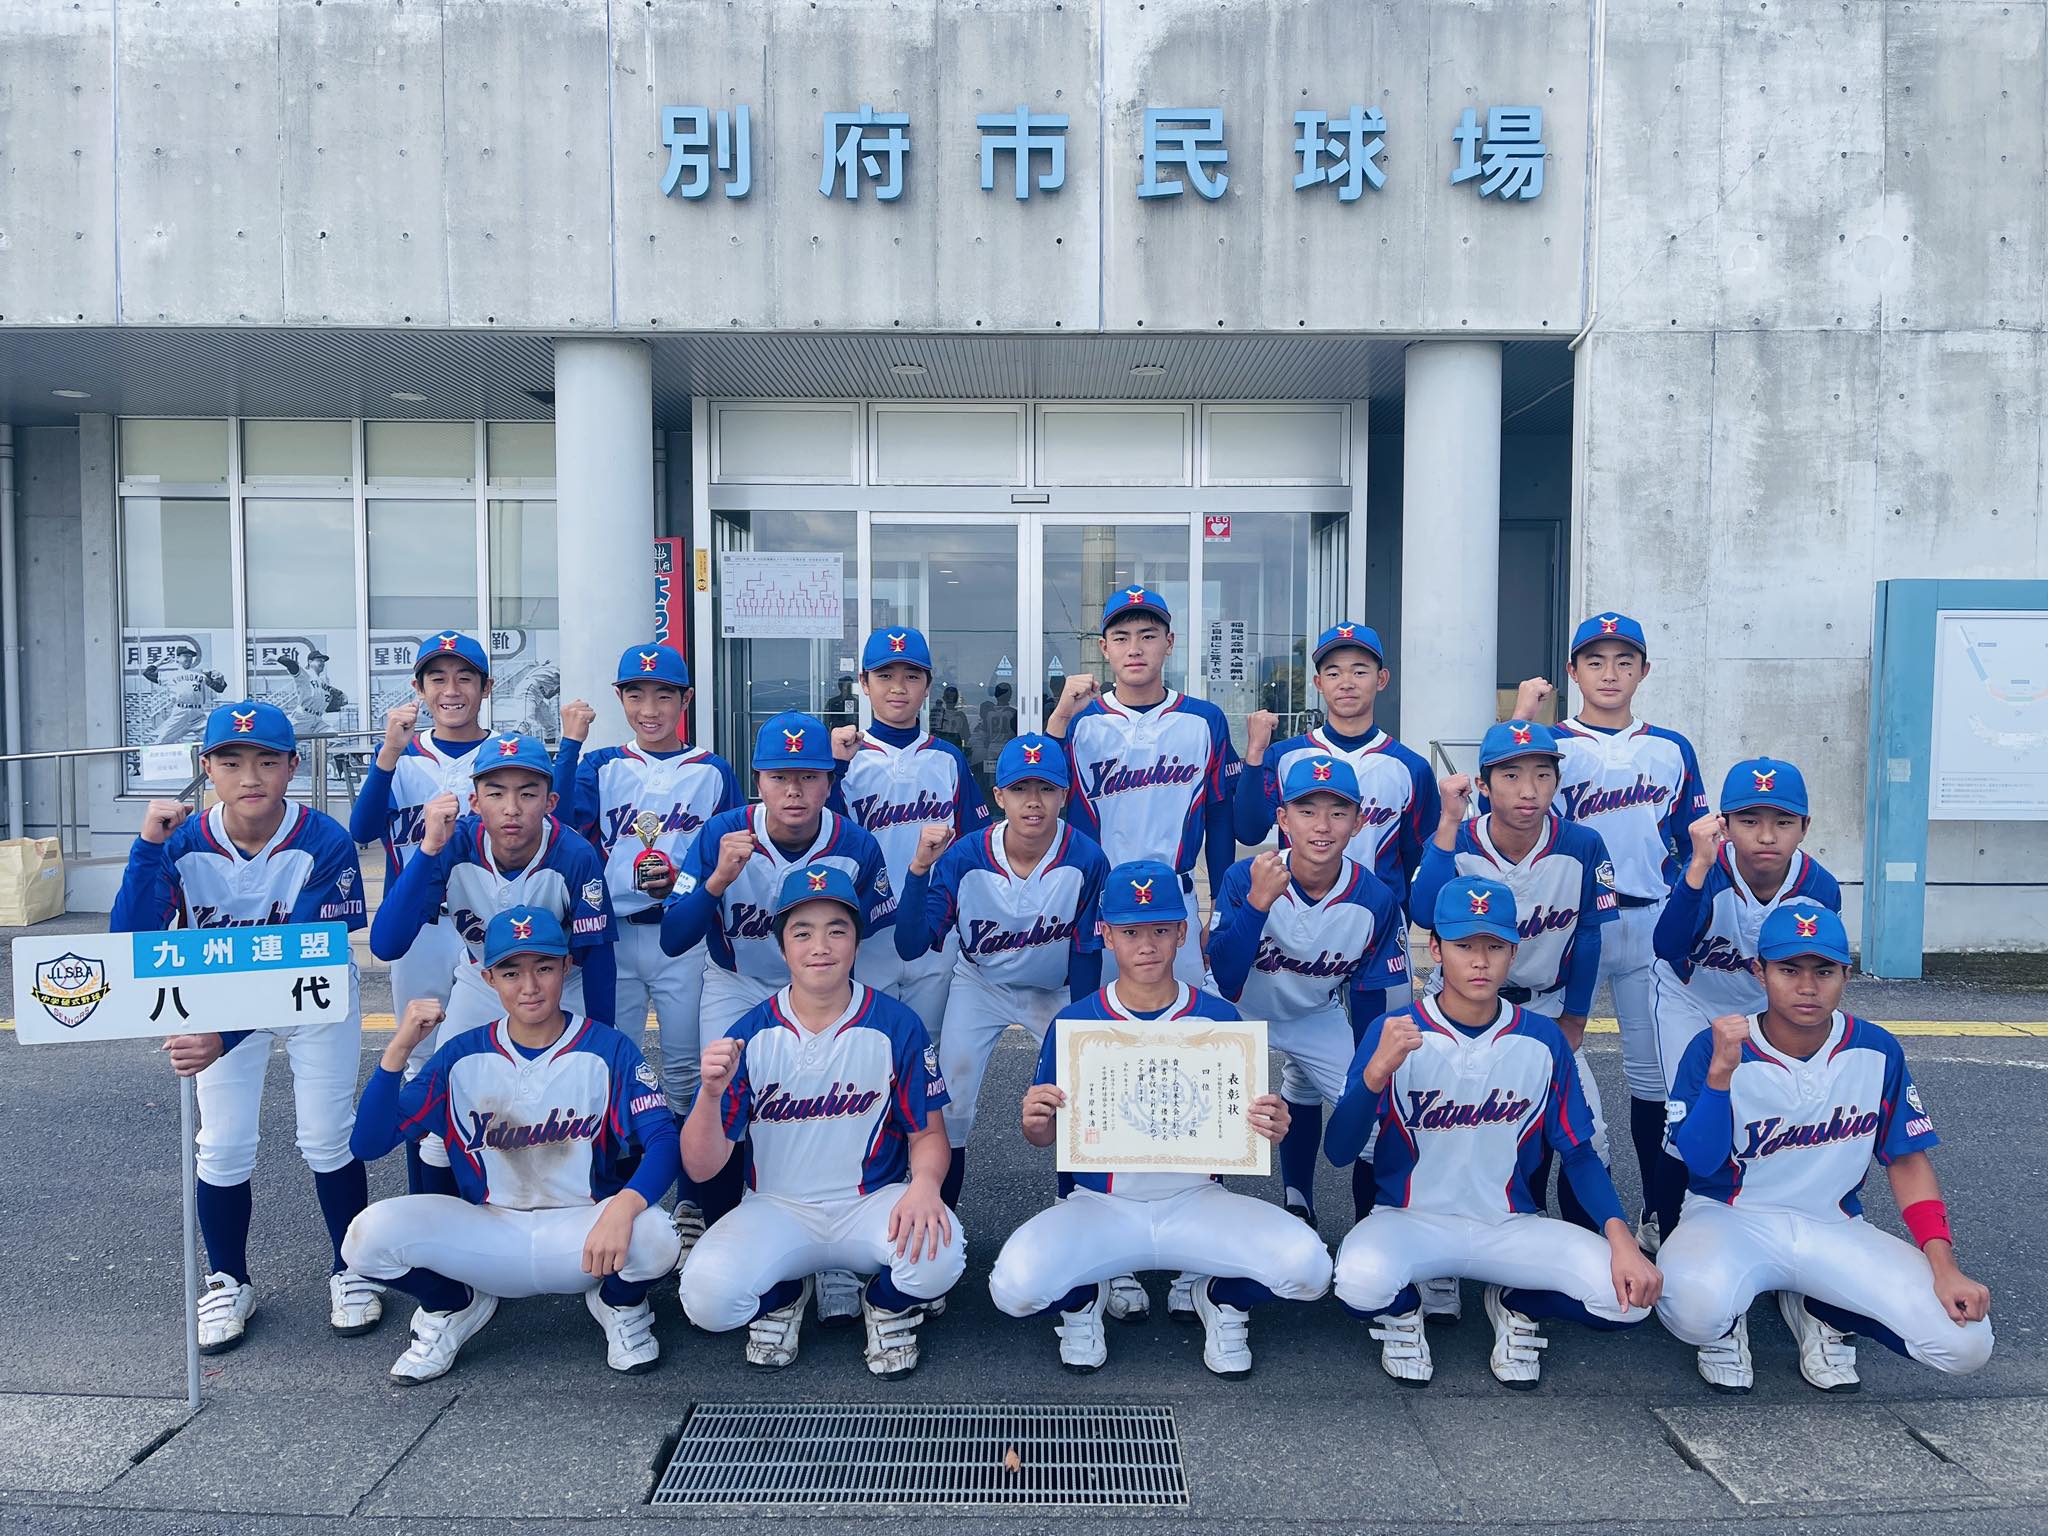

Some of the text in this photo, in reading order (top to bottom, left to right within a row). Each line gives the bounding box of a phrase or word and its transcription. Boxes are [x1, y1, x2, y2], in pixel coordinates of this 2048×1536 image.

[660, 104, 1545, 200] 別府市民球場
[1210, 622, 1221, 680] ご自由にご覧下さい
[1087, 755, 1200, 799] Yatsushiro
[153, 931, 330, 969] 九州連盟
[40, 992, 101, 1007] 中学硬式野球
[53, 1006, 90, 1024] SENIORS
[149, 976, 331, 1022] 八代
[1202, 1068, 1210, 1091] 四位
[1227, 1072, 1240, 1116] 表彰状
[750, 1082, 881, 1124] Yatsushiro
[1737, 1105, 1880, 1159] Yatsushiro
